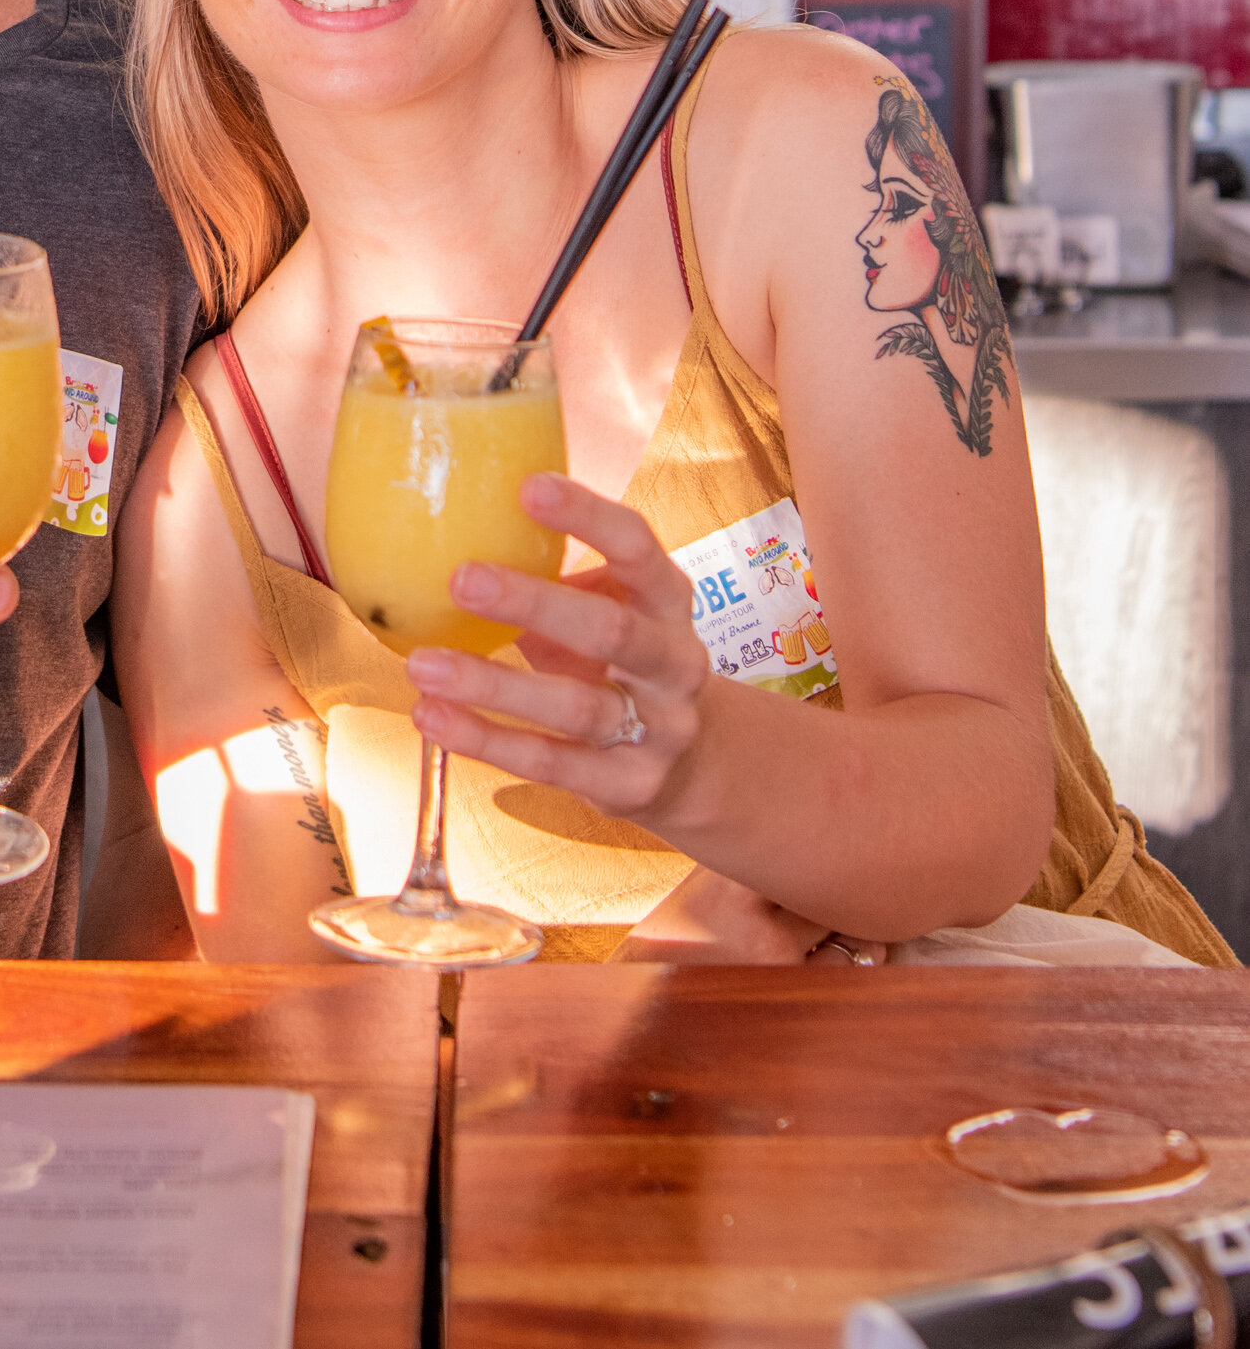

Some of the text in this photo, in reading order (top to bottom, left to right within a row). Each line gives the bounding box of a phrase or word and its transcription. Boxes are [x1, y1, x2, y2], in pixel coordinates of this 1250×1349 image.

[682, 548, 719, 571] LONGS
[748, 541, 789, 569] AND AROUND
[732, 602, 755, 619] TOUR
[718, 631, 728, 646] of
[729, 618, 763, 637] Broome
